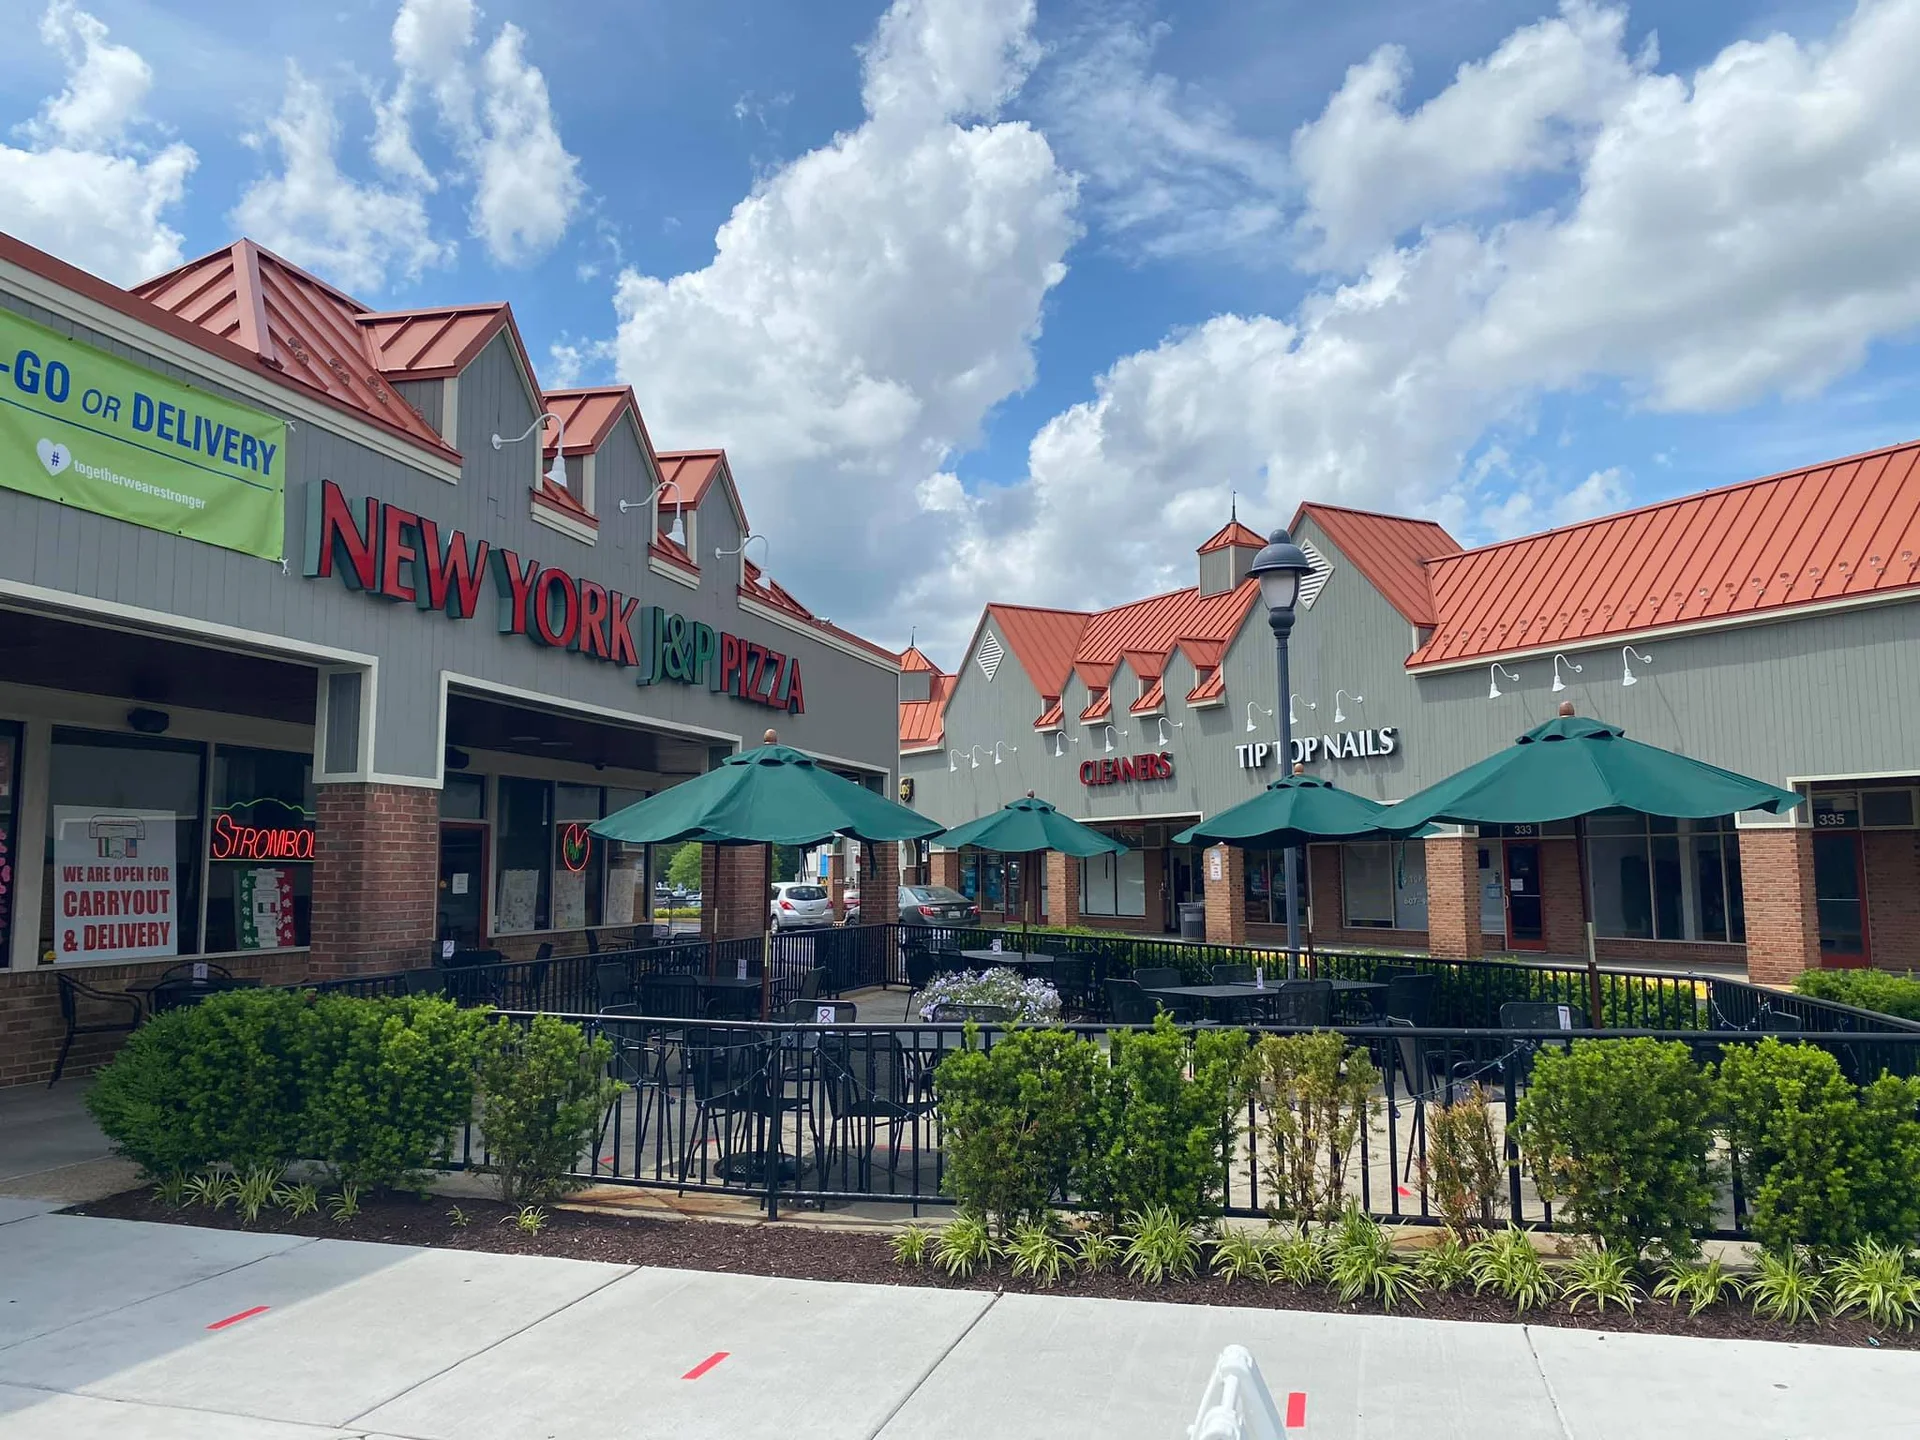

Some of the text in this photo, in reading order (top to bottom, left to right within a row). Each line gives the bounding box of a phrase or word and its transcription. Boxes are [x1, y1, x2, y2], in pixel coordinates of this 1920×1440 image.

[82, 389, 121, 422] OR
[132, 392, 277, 475] DELIVERY
[316, 479, 806, 715] NEW YORK J&P PIZZA
[1235, 743, 1268, 768] TIP
[1323, 727, 1396, 759] NAILS
[1079, 751, 1173, 786] CLEANERS
[1514, 825, 1532, 834] 333
[1819, 814, 1845, 825] 335
[63, 866, 169, 882] WE ARE OPEN FOR
[63, 889, 170, 917] CARRYOUT
[63, 922, 170, 952] & DELIVERY
